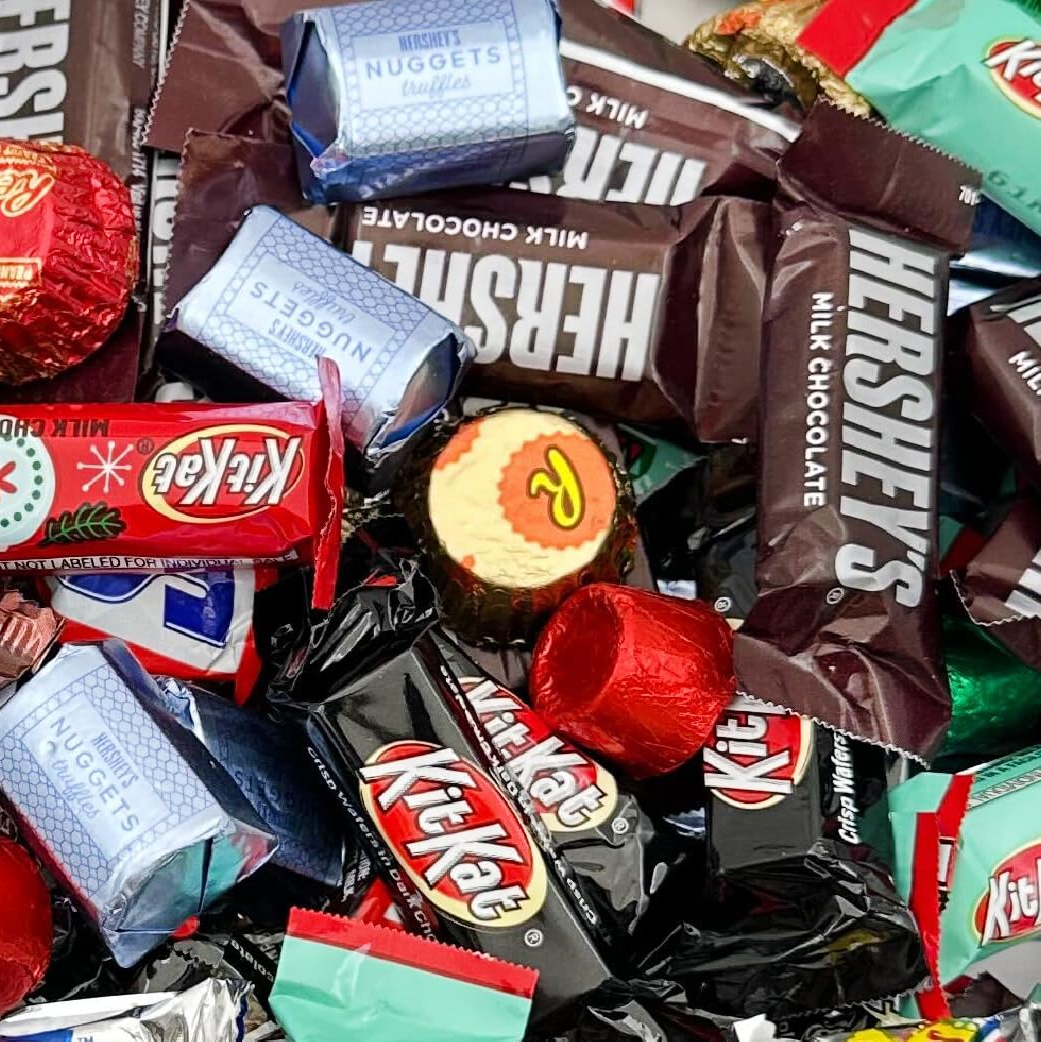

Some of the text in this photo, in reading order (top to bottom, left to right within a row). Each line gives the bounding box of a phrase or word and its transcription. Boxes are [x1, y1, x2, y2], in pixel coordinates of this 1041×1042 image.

[366, 47, 502, 79] NUGGETS
[399, 30, 462, 51] HERSHEY'S
[402, 76, 471, 97] truffles
[585, 93, 648, 130] MILK
[362, 206, 589, 250] CHOCOLATE MILK
[247, 278, 373, 363] NUGGETS
[804, 292, 834, 507] MILK CHOCOLATE
[1008, 350, 1041, 397] MIL
[51, 418, 108, 437] MILK
[834, 228, 940, 608] HERSHEY'S
[153, 438, 303, 506] KitKat
[15, 555, 156, 570] NOT LABELED FOR
[48, 715, 141, 834] NUGGETS
[89, 730, 139, 789] HERSHEY'S
[702, 700, 796, 797] Kit
[47, 756, 103, 821] truffles
[835, 795, 864, 844] Crisp
[304, 744, 338, 791] Crisp
[376, 847, 393, 868] in
[387, 865, 420, 909] Dark
[360, 745, 533, 921] KitKat
[981, 870, 1041, 947] Kit
